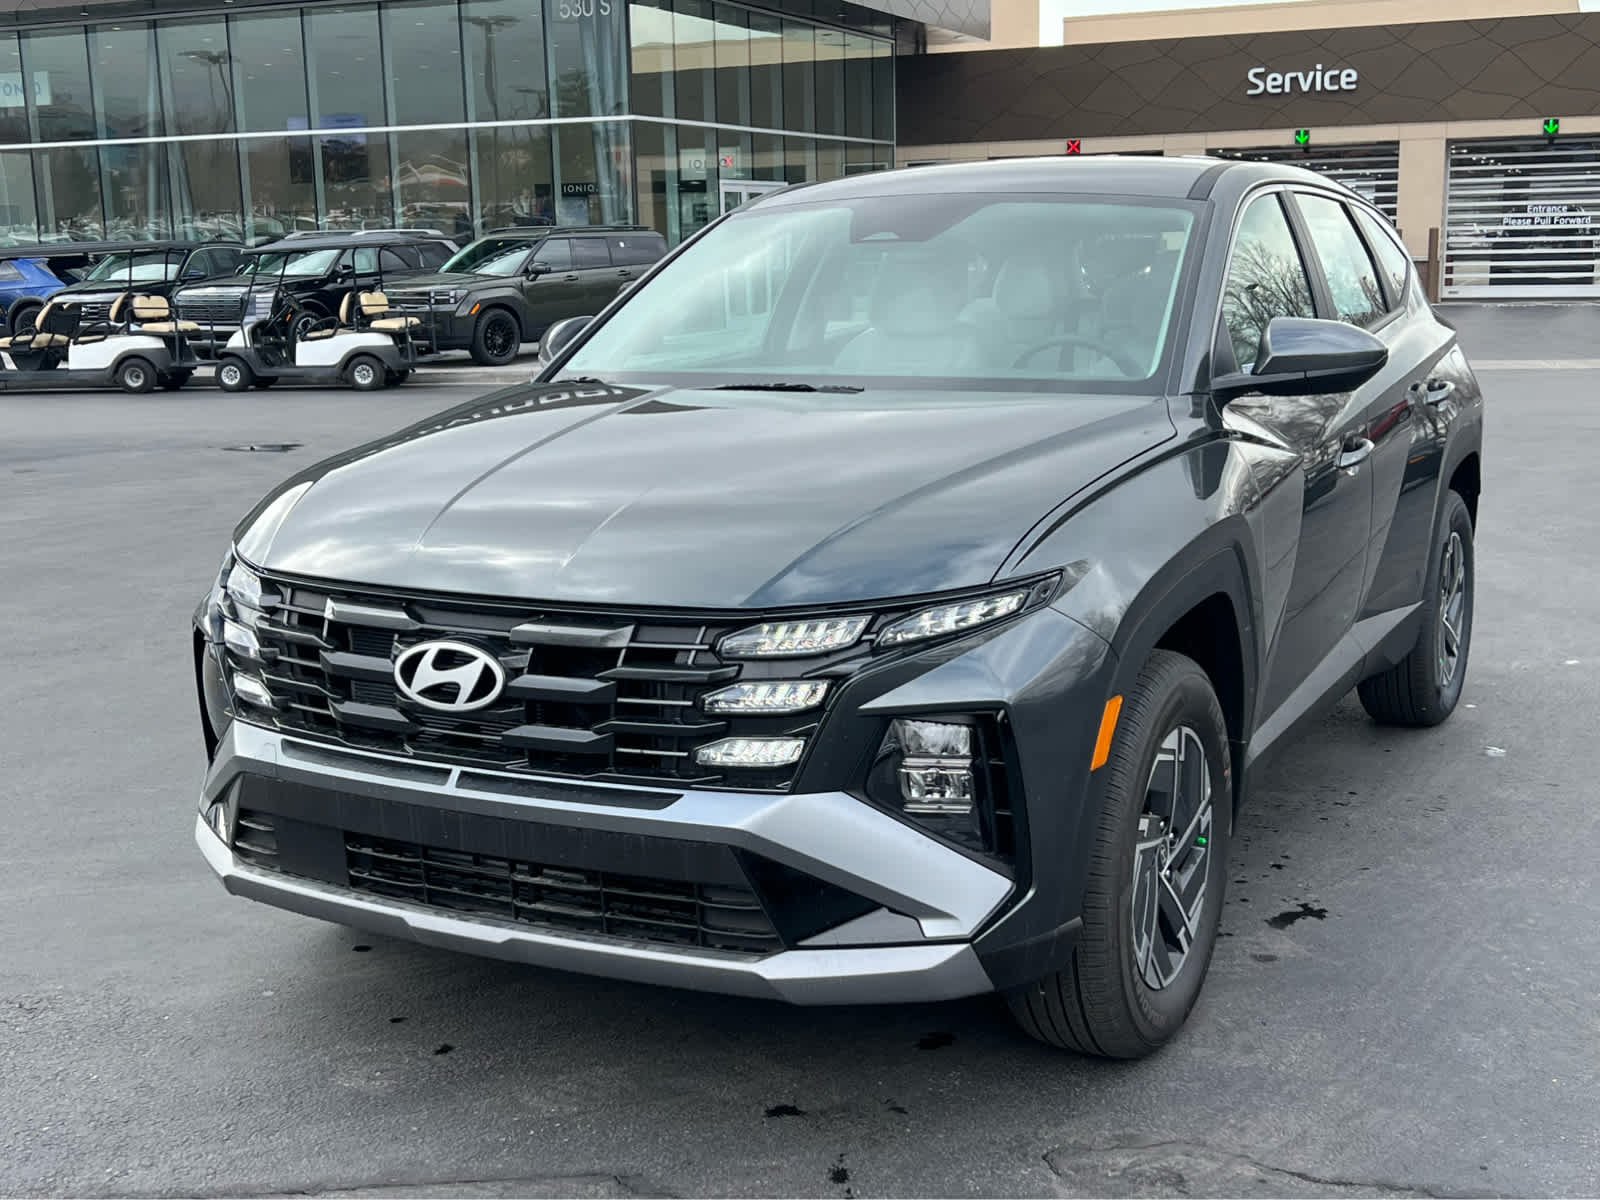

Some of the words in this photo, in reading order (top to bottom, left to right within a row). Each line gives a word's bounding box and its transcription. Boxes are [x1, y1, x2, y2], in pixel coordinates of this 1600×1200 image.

[1246, 63, 1358, 95] Service
[1527, 204, 1568, 214] Entrance
[1503, 217, 1532, 226] Please
[1534, 216, 1551, 225] Pull
[1553, 216, 1591, 225] Forward
